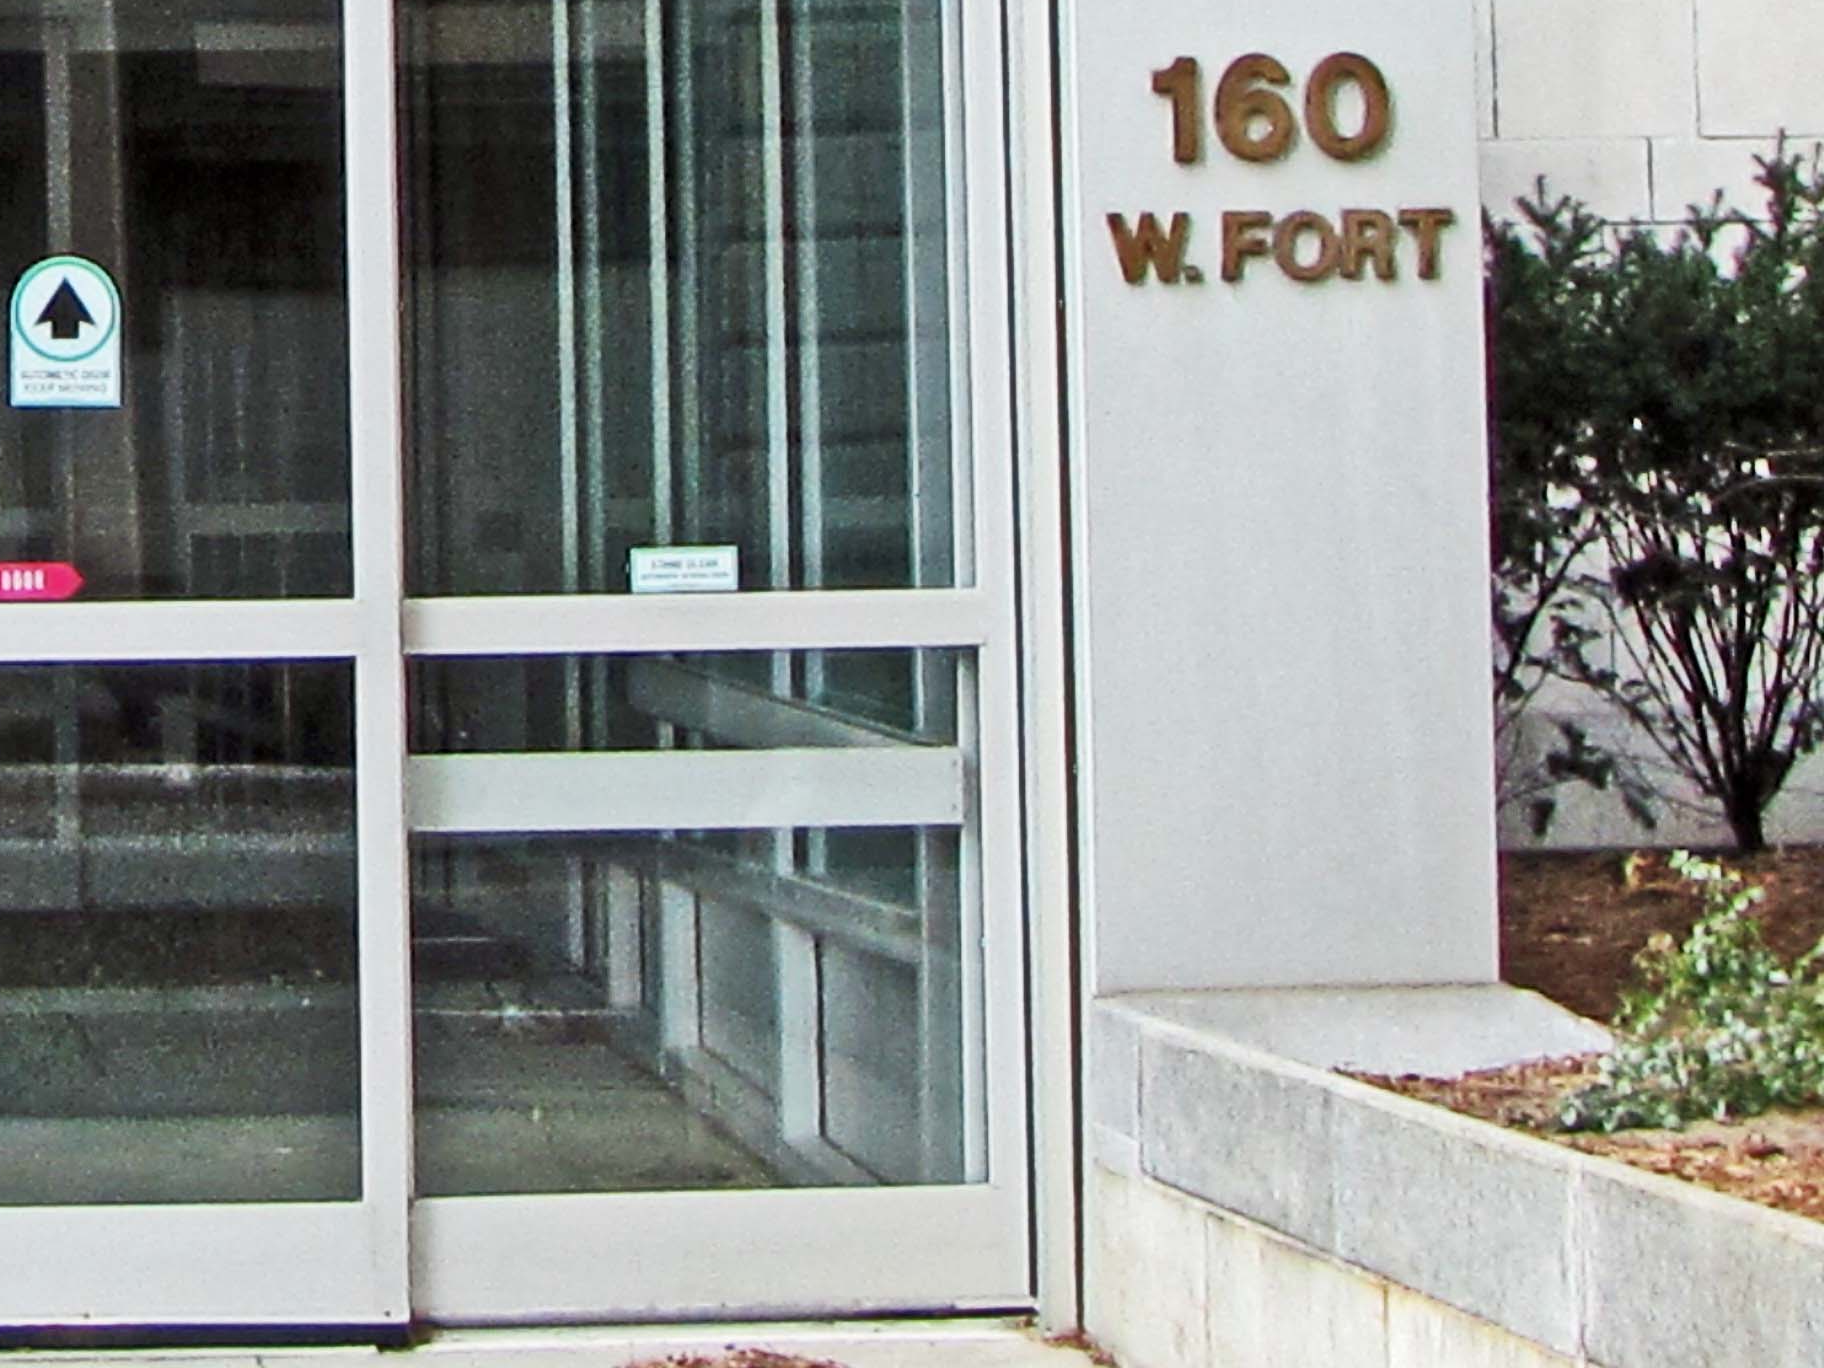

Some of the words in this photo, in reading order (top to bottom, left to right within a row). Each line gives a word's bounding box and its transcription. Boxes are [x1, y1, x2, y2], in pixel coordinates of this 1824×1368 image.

[1151, 51, 1391, 164] 160
[1106, 211, 1203, 285] W.
[1220, 207, 1454, 284] FORT
